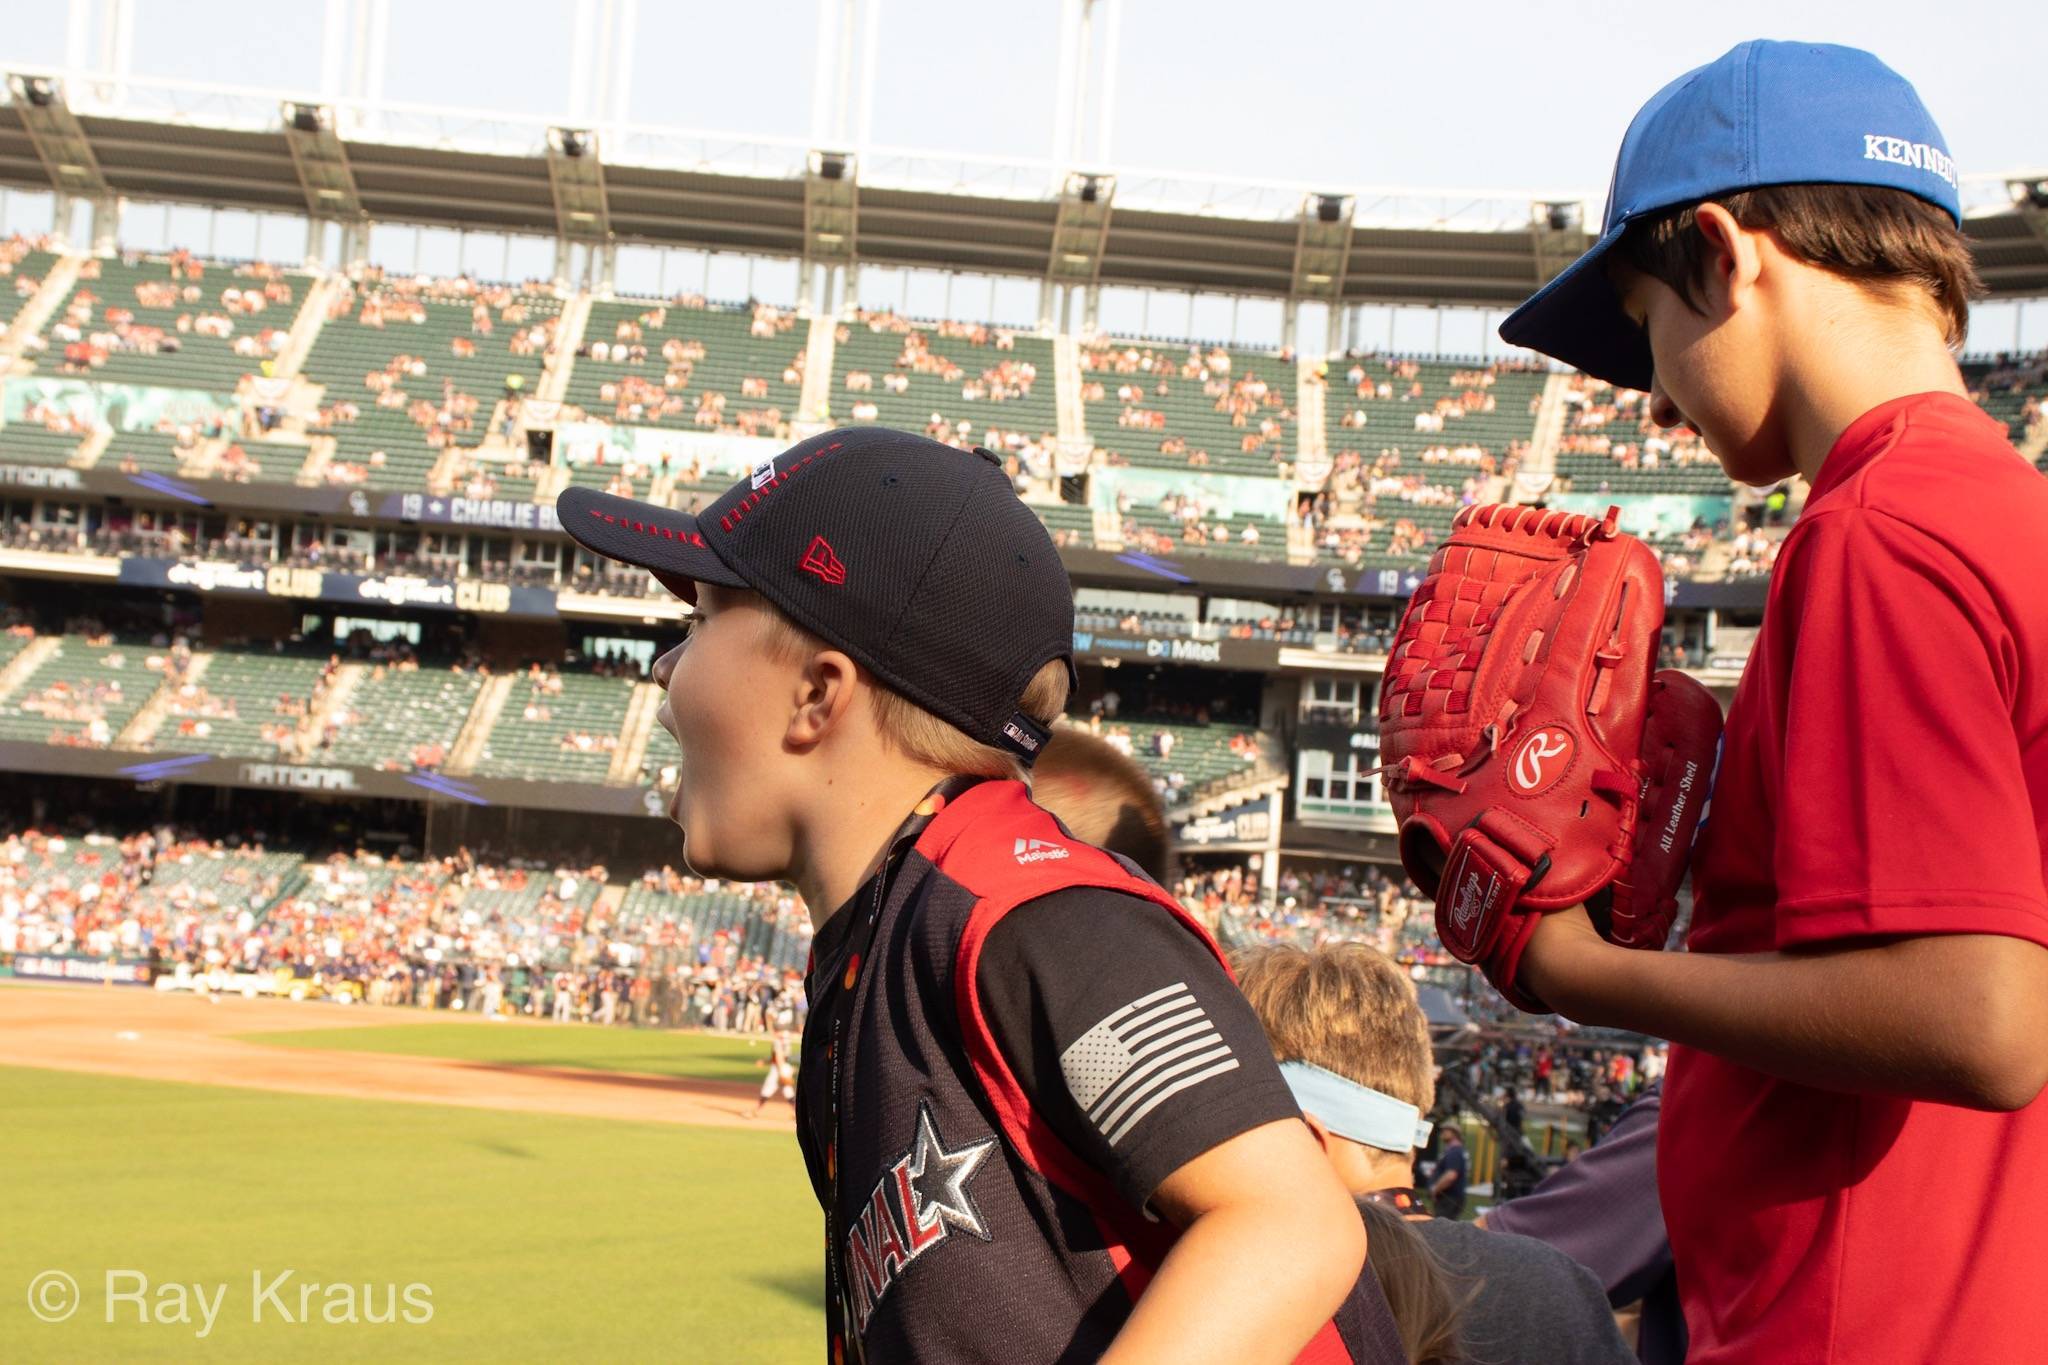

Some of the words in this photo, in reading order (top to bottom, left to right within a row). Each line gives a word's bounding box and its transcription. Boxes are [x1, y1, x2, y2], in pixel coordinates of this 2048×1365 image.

[451, 497, 535, 528] CHARLIE
[266, 567, 323, 598] CLUB
[456, 581, 511, 612] CLUB
[1680, 760, 1698, 792] Shell
[1665, 792, 1687, 835] Leather
[1016, 848, 1070, 865] Majestic
[1660, 834, 1674, 853] All
